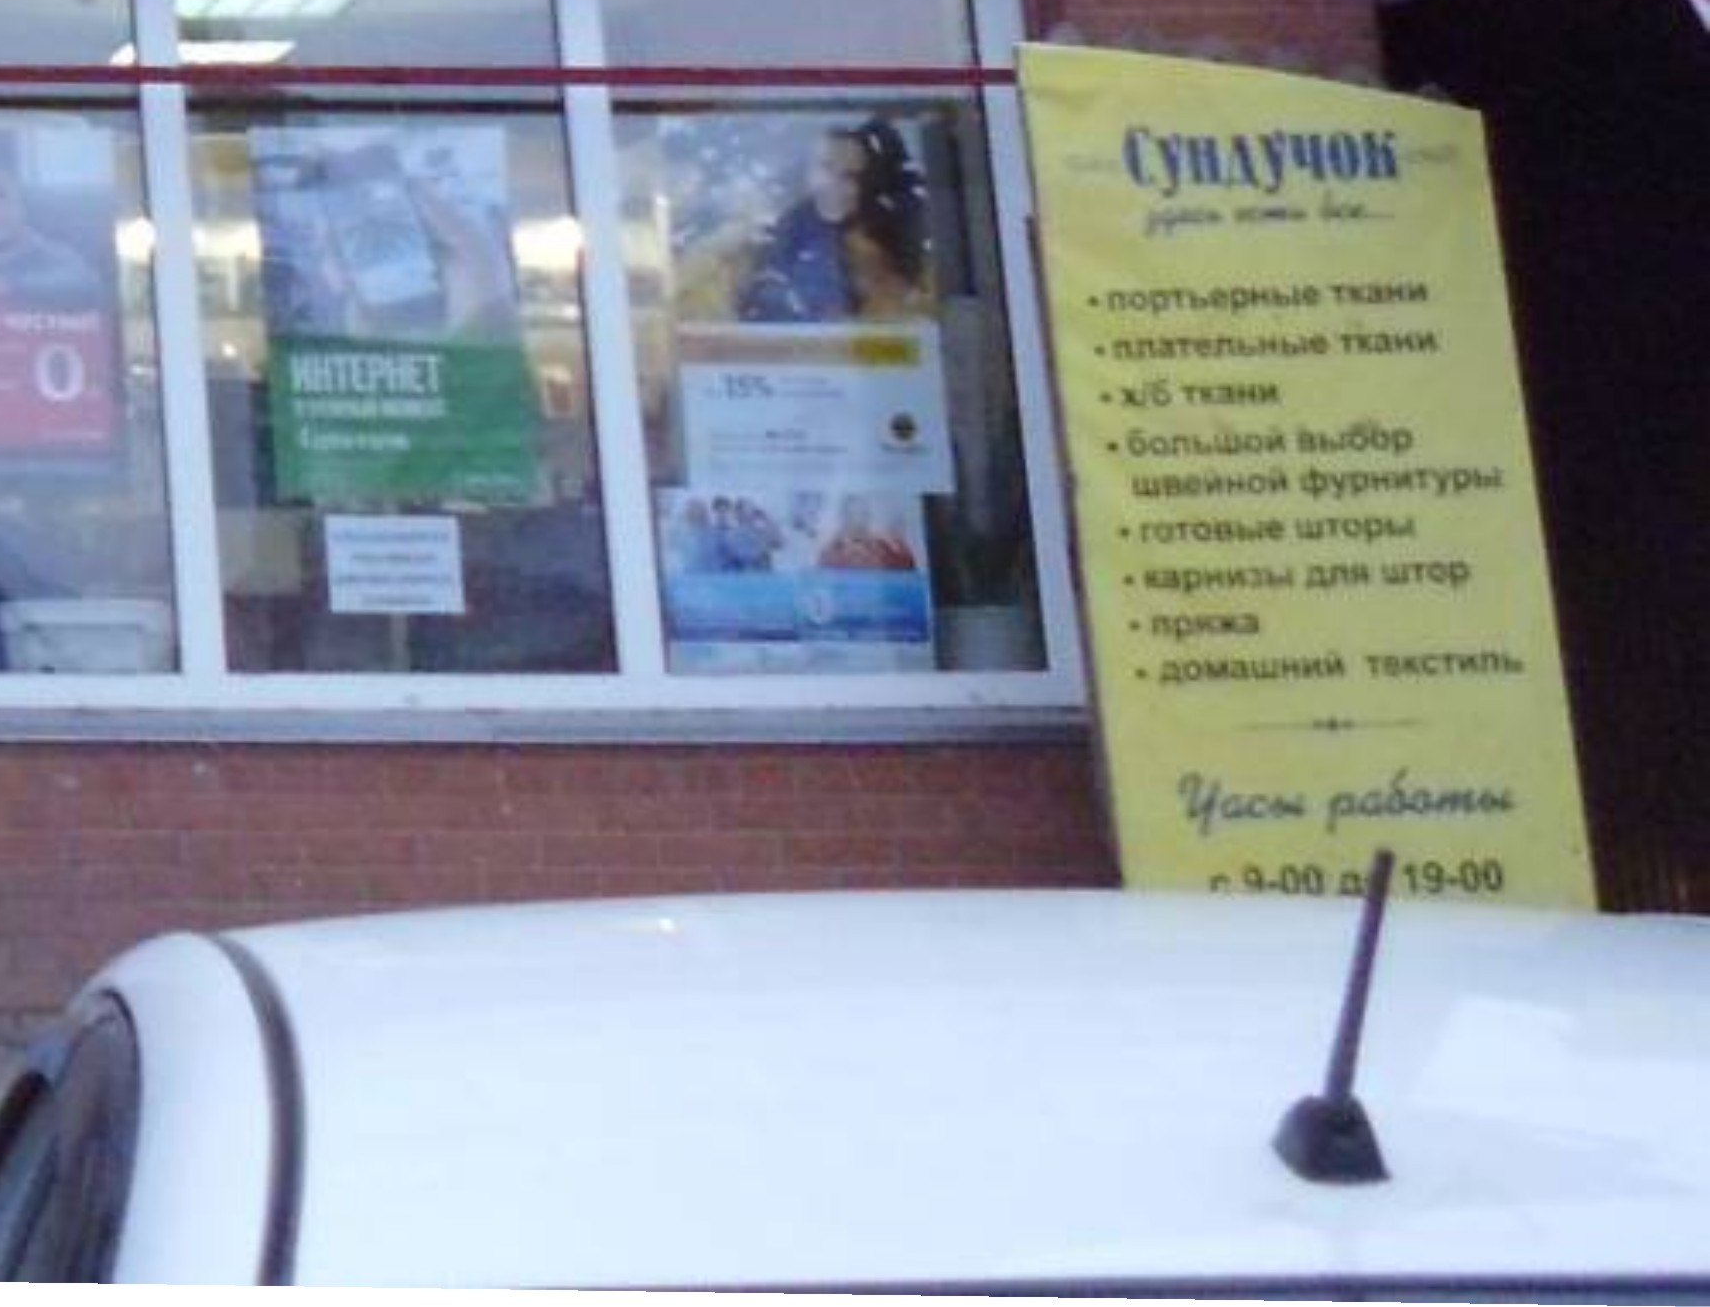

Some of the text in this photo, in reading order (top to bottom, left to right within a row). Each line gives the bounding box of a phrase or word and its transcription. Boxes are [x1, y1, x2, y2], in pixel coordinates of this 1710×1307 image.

[1107, 281, 1429, 315] портьерные ткани
[1112, 329, 1440, 361] плательные ткани
[1183, 382, 1279, 406] ткани
[1127, 425, 1414, 458] большой выбор
[1132, 465, 1504, 499] швейной фурнитуры
[1140, 515, 1415, 544] готовые шторы
[1143, 559, 1471, 592] карнизы для штор
[1151, 612, 1260, 642] пряжа
[1160, 651, 1525, 685] домашний текстиль
[1177, 767, 1516, 837] Часы работы
[1242, 862, 1325, 895] 9-00
[1402, 858, 1504, 894] 19-00
